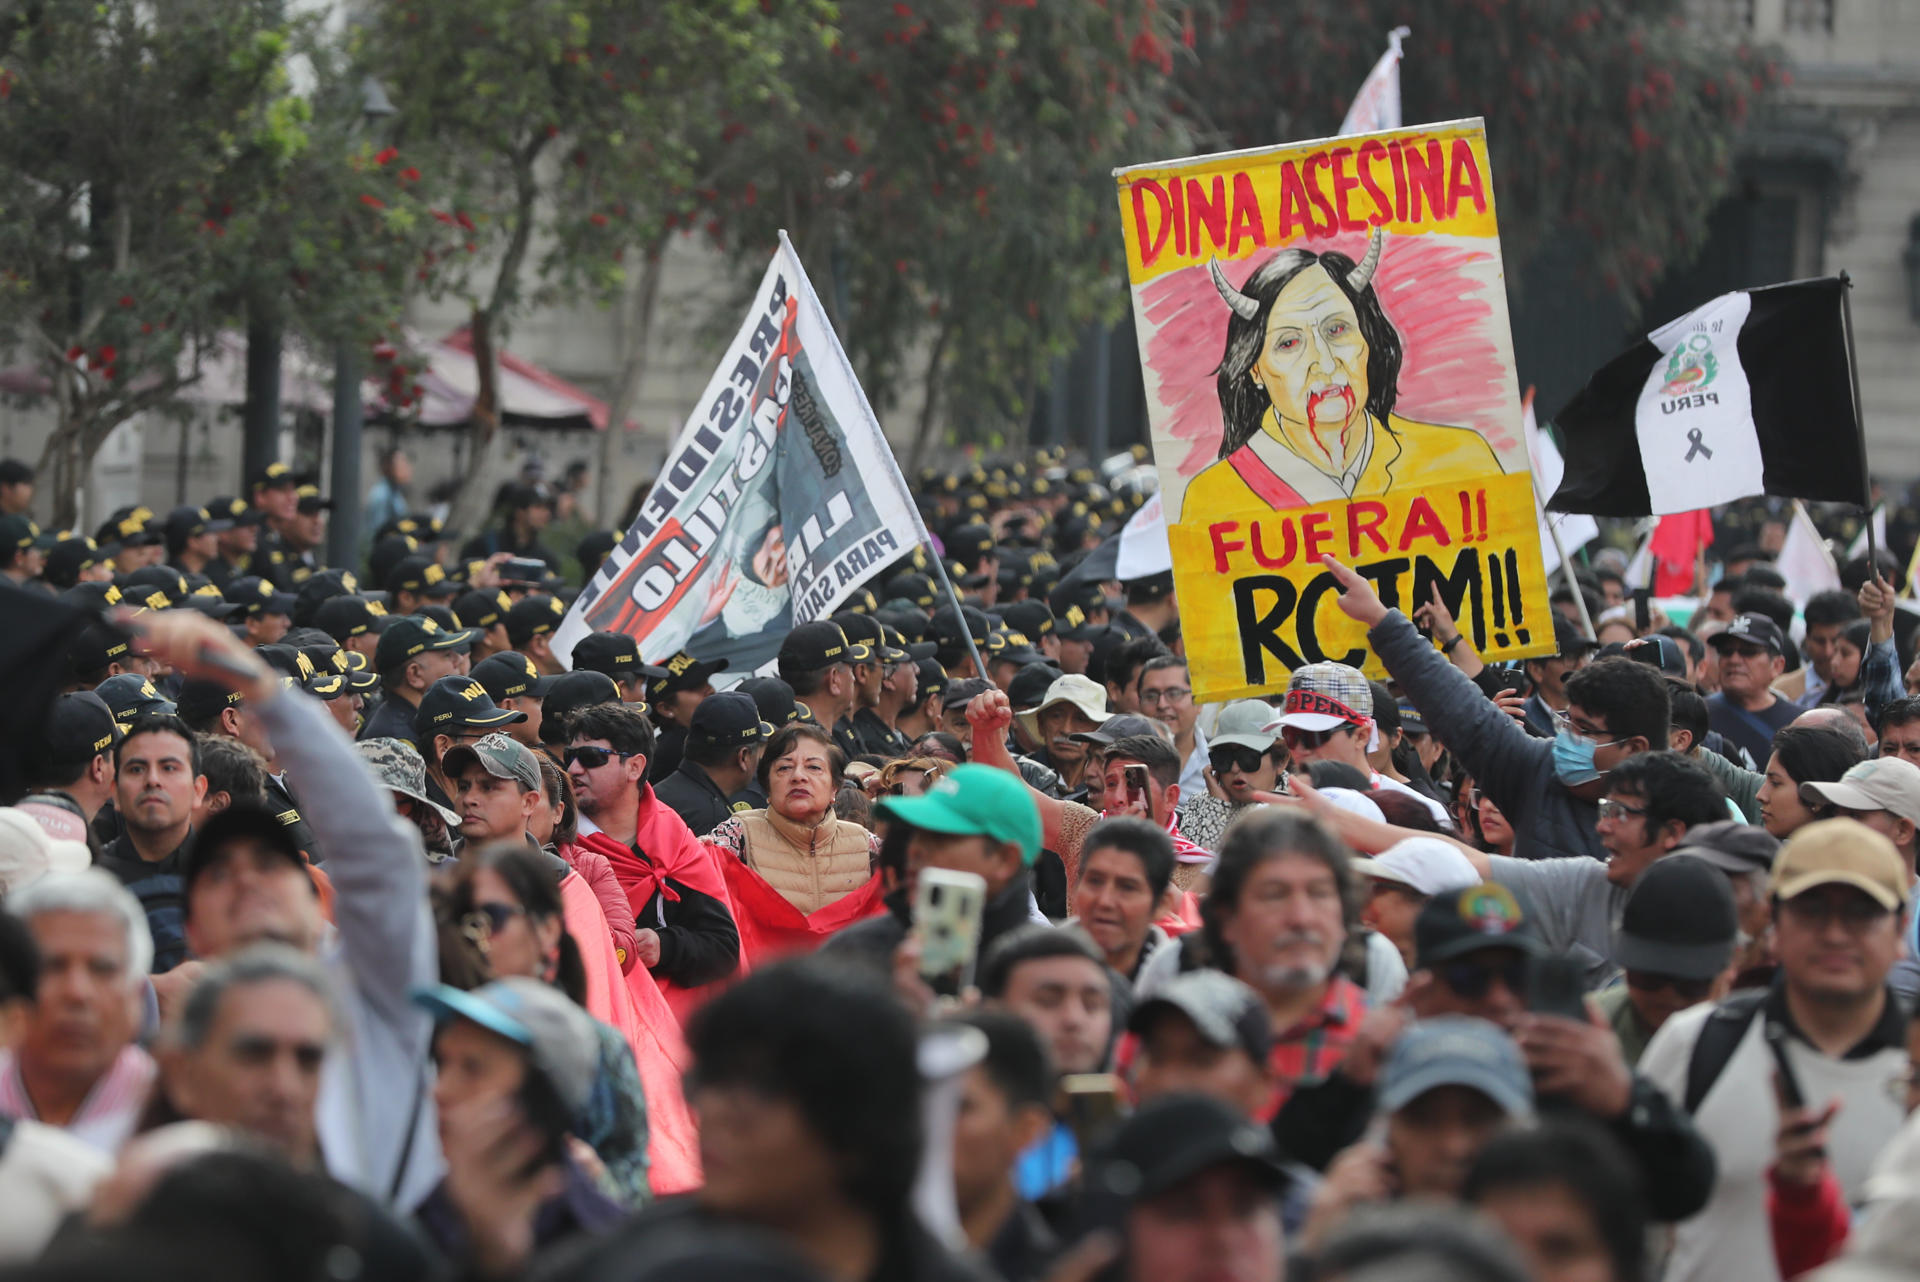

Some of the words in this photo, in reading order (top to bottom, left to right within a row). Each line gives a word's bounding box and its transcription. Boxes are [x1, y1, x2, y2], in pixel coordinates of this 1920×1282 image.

[1131, 171, 1266, 268] DINA
[1279, 136, 1488, 240] ASESINA
[1208, 489, 1489, 574] FUERA!!
[117, 707, 138, 719] PERU
[433, 712, 453, 723] PERU
